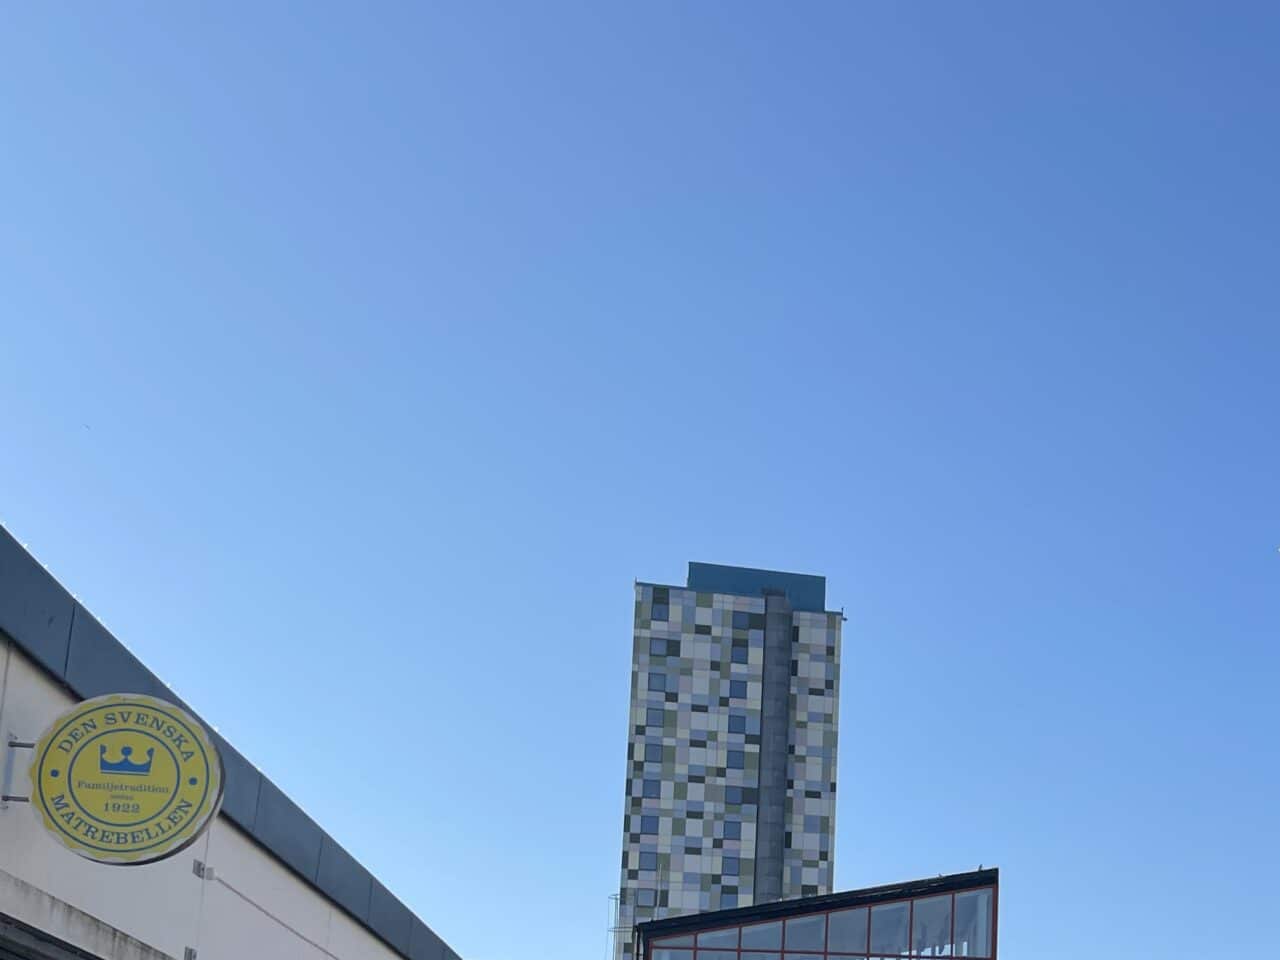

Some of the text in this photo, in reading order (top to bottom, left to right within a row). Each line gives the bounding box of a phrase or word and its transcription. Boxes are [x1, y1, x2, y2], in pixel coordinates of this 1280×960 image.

[58, 711, 195, 762] DEN SVENSKA
[51, 793, 193, 845] MATREBELLEN
[104, 802, 140, 814] 1922
